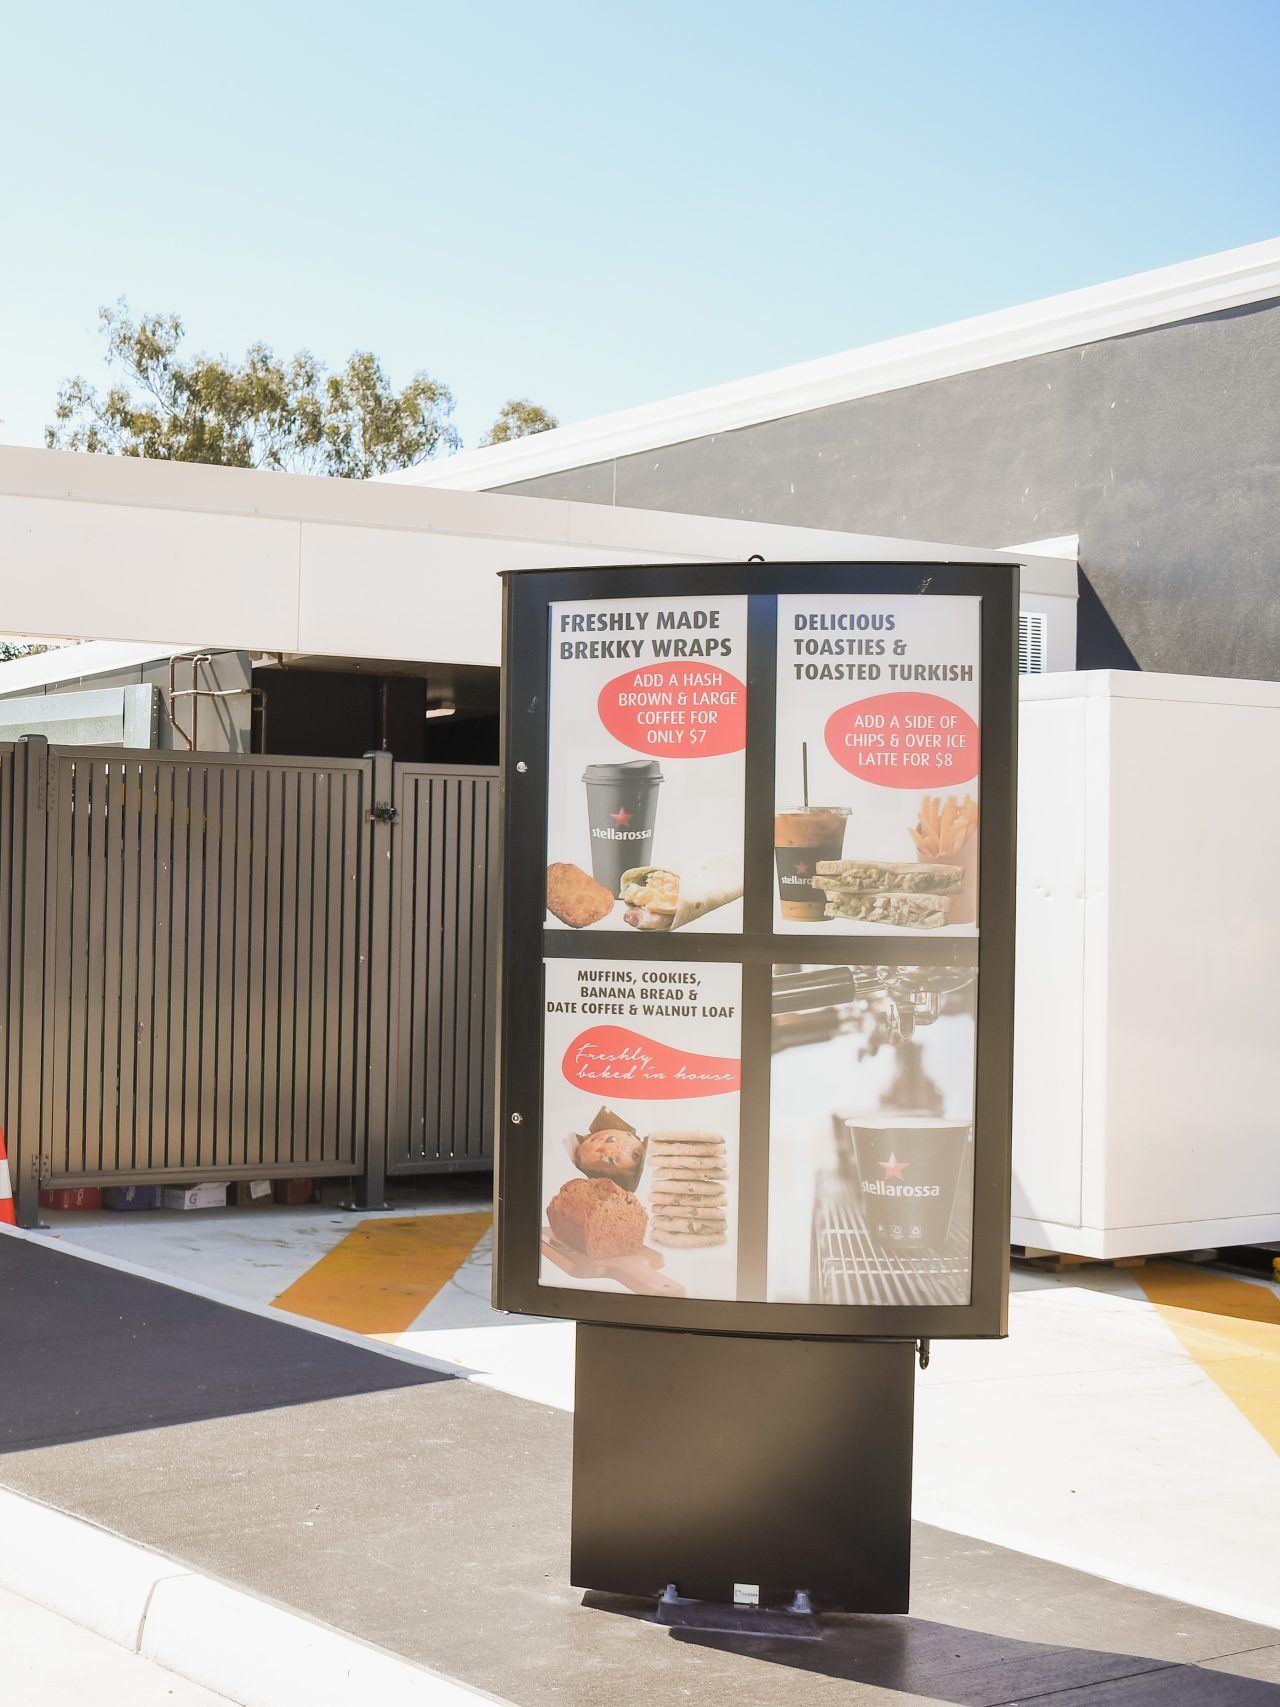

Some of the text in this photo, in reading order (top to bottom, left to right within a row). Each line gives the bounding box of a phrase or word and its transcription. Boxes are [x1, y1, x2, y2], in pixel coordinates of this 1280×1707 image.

[560, 610, 720, 633] FRESHLY MADE
[794, 614, 895, 631] DELICIOUS
[560, 638, 732, 660] BREKKY WRAPS
[793, 638, 907, 656] TOASTIES &
[633, 673, 722, 687] ADD A HASH
[793, 663, 973, 682] TOASTED TURKISH
[618, 692, 738, 706] BROWN & LARGE
[637, 711, 718, 725] COFFEE FOR
[854, 715, 958, 729] ADD A SIDE OF
[647, 728, 707, 745] ONLY $7
[844, 734, 967, 748] CHIPS & OVER ICE
[858, 752, 953, 768] LATTE FOR $8
[592, 828, 652, 840] stellarossa
[781, 875, 813, 885] stellaro
[577, 970, 701, 986] MUFFINS, COOKIES,
[580, 986, 698, 1000] BANANA BREAD &
[547, 1002, 735, 1018] DATE COFFEE & WALNUT LOAF
[575, 1042, 653, 1071] Freshly
[576, 1064, 735, 1081] baked in house
[862, 1180, 940, 1197] stellarossa
